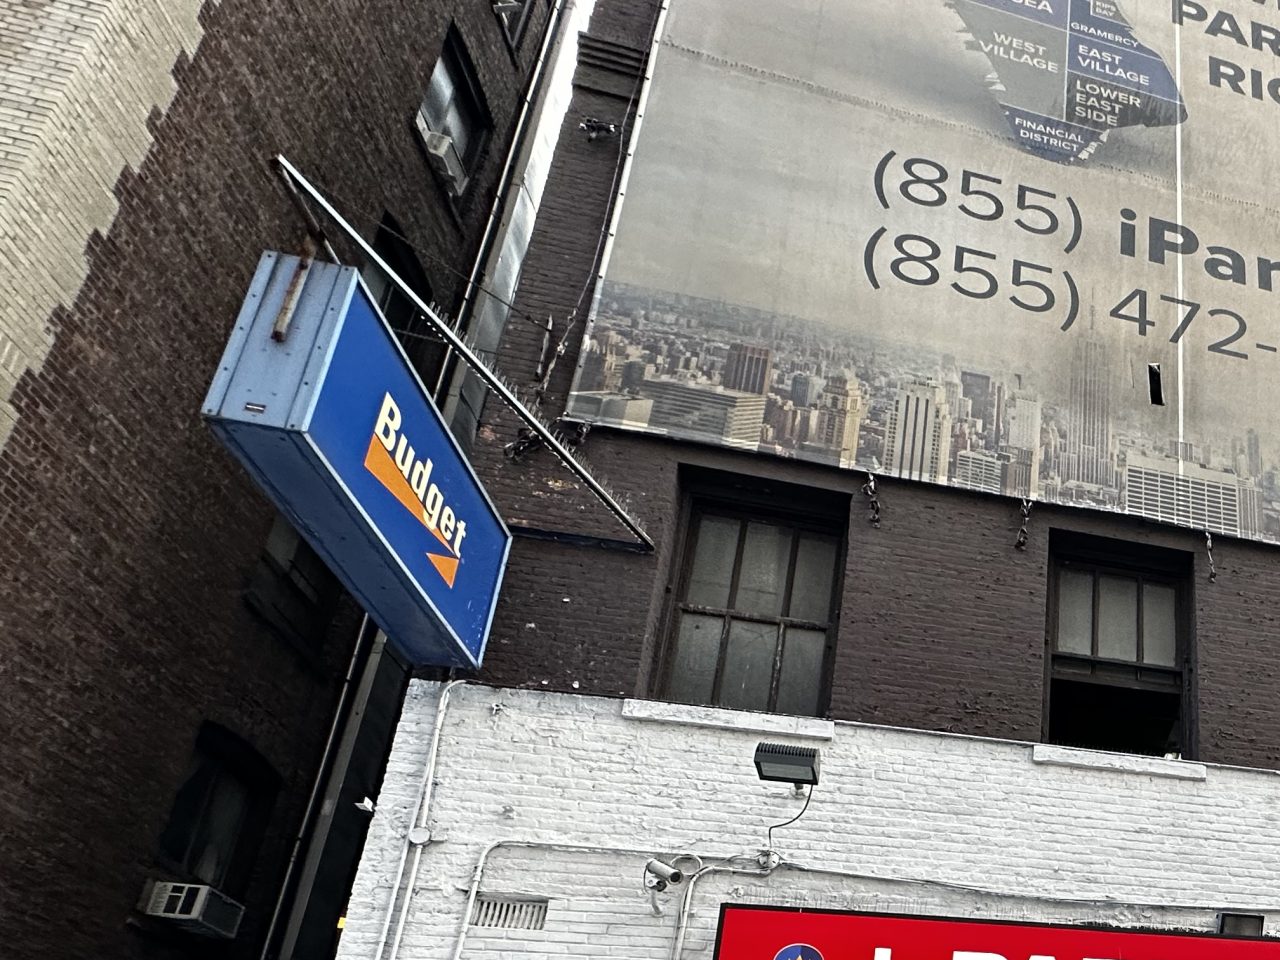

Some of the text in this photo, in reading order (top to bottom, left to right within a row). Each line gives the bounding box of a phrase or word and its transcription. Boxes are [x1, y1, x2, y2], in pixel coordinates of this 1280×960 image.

[993, 31, 1047, 56] WEST
[1071, 21, 1139, 48] GRAMERCY
[979, 40, 1058, 73] VILLAGE
[1078, 44, 1122, 65] EAST
[1077, 55, 1150, 86] VILLAGE
[1076, 79, 1141, 108] LOWER
[1076, 93, 1123, 114] EAST
[1075, 106, 1118, 127] SIDE
[1015, 117, 1085, 144] FINANCIAL
[1019, 129, 1080, 152] DISTRICT
[873, 149, 1083, 254] (855)
[863, 226, 1080, 332] (855)
[374, 391, 467, 559] Budget
